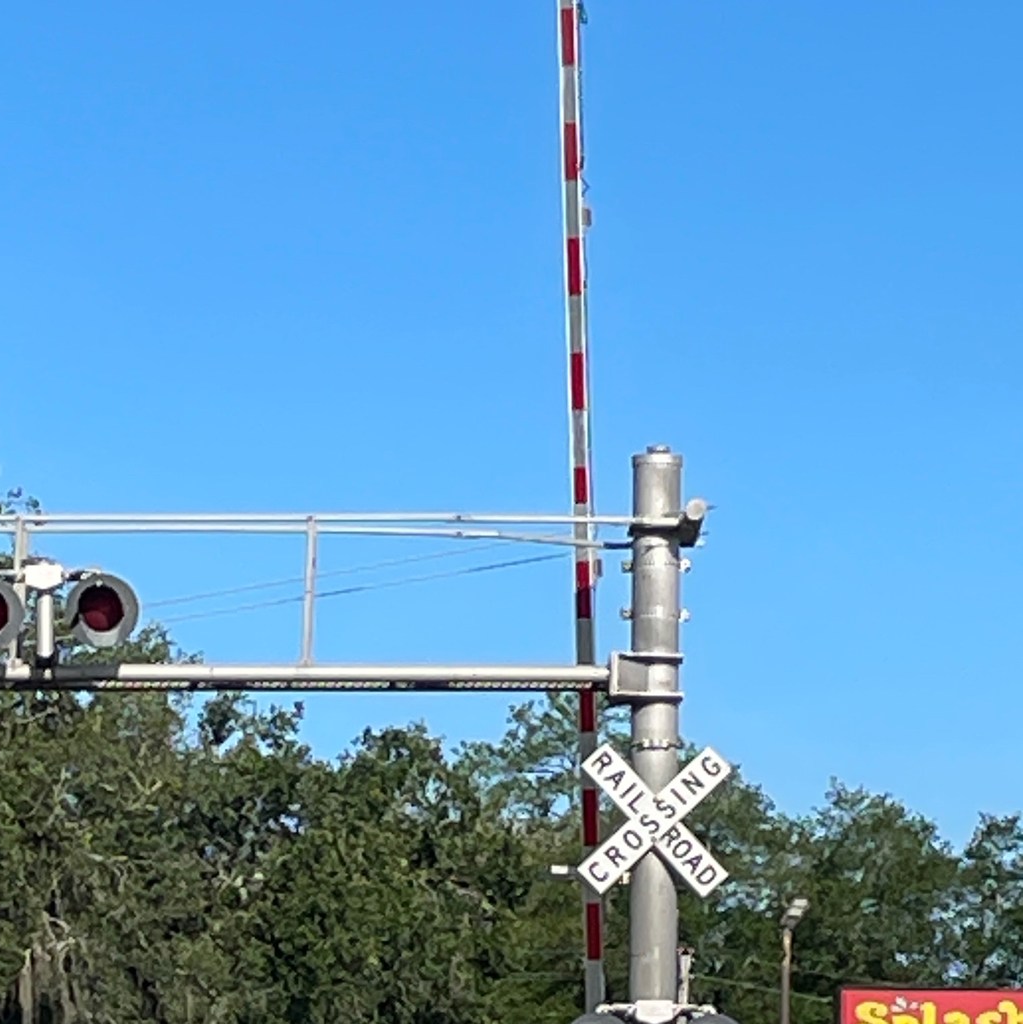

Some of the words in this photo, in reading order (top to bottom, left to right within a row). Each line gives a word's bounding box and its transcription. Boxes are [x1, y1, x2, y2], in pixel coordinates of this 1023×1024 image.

[588, 756, 722, 882] CROSSING
[591, 751, 646, 815] RAIL
[660, 824, 718, 886] ROAD
